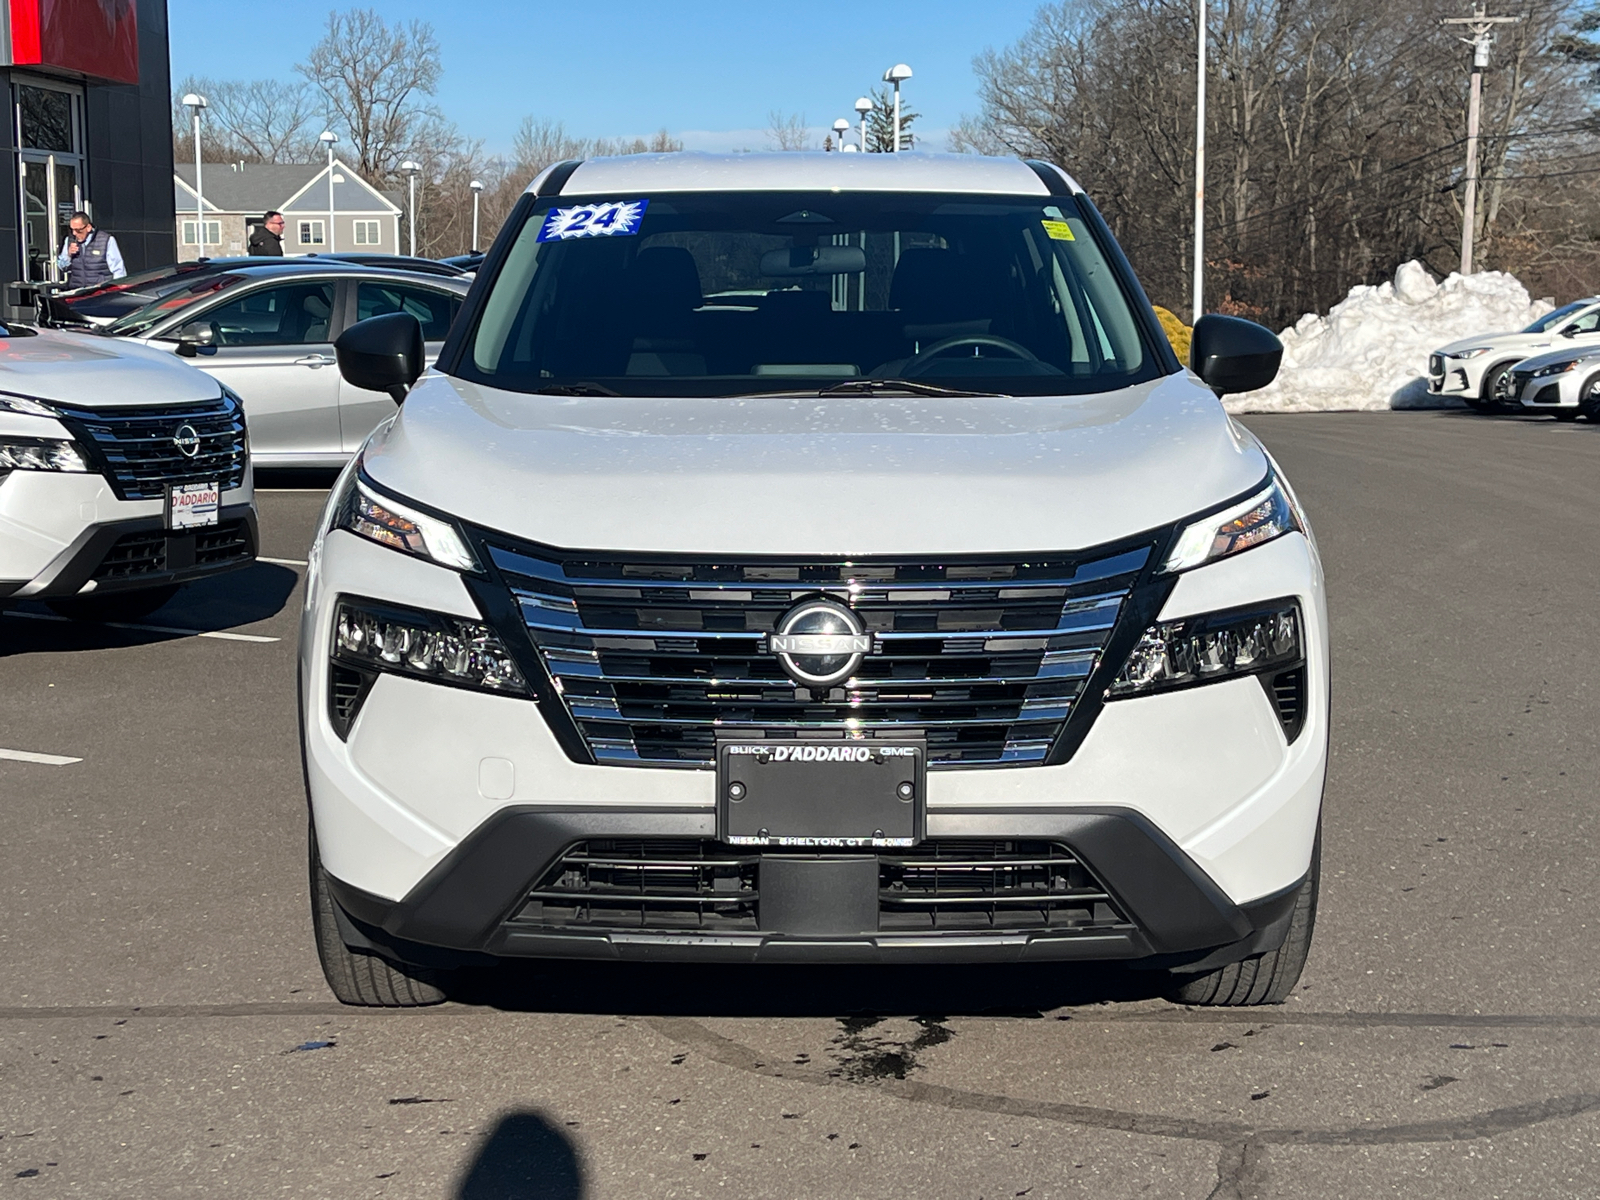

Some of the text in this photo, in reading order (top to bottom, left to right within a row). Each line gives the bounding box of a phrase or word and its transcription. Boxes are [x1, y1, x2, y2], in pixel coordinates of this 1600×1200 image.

[564, 207, 620, 231] 24
[172, 492, 217, 507] D'ADDARIO
[772, 638, 868, 651] NISSAN
[730, 746, 914, 761] BUICK D'ADDARIO GMC
[846, 838, 865, 847] CT
